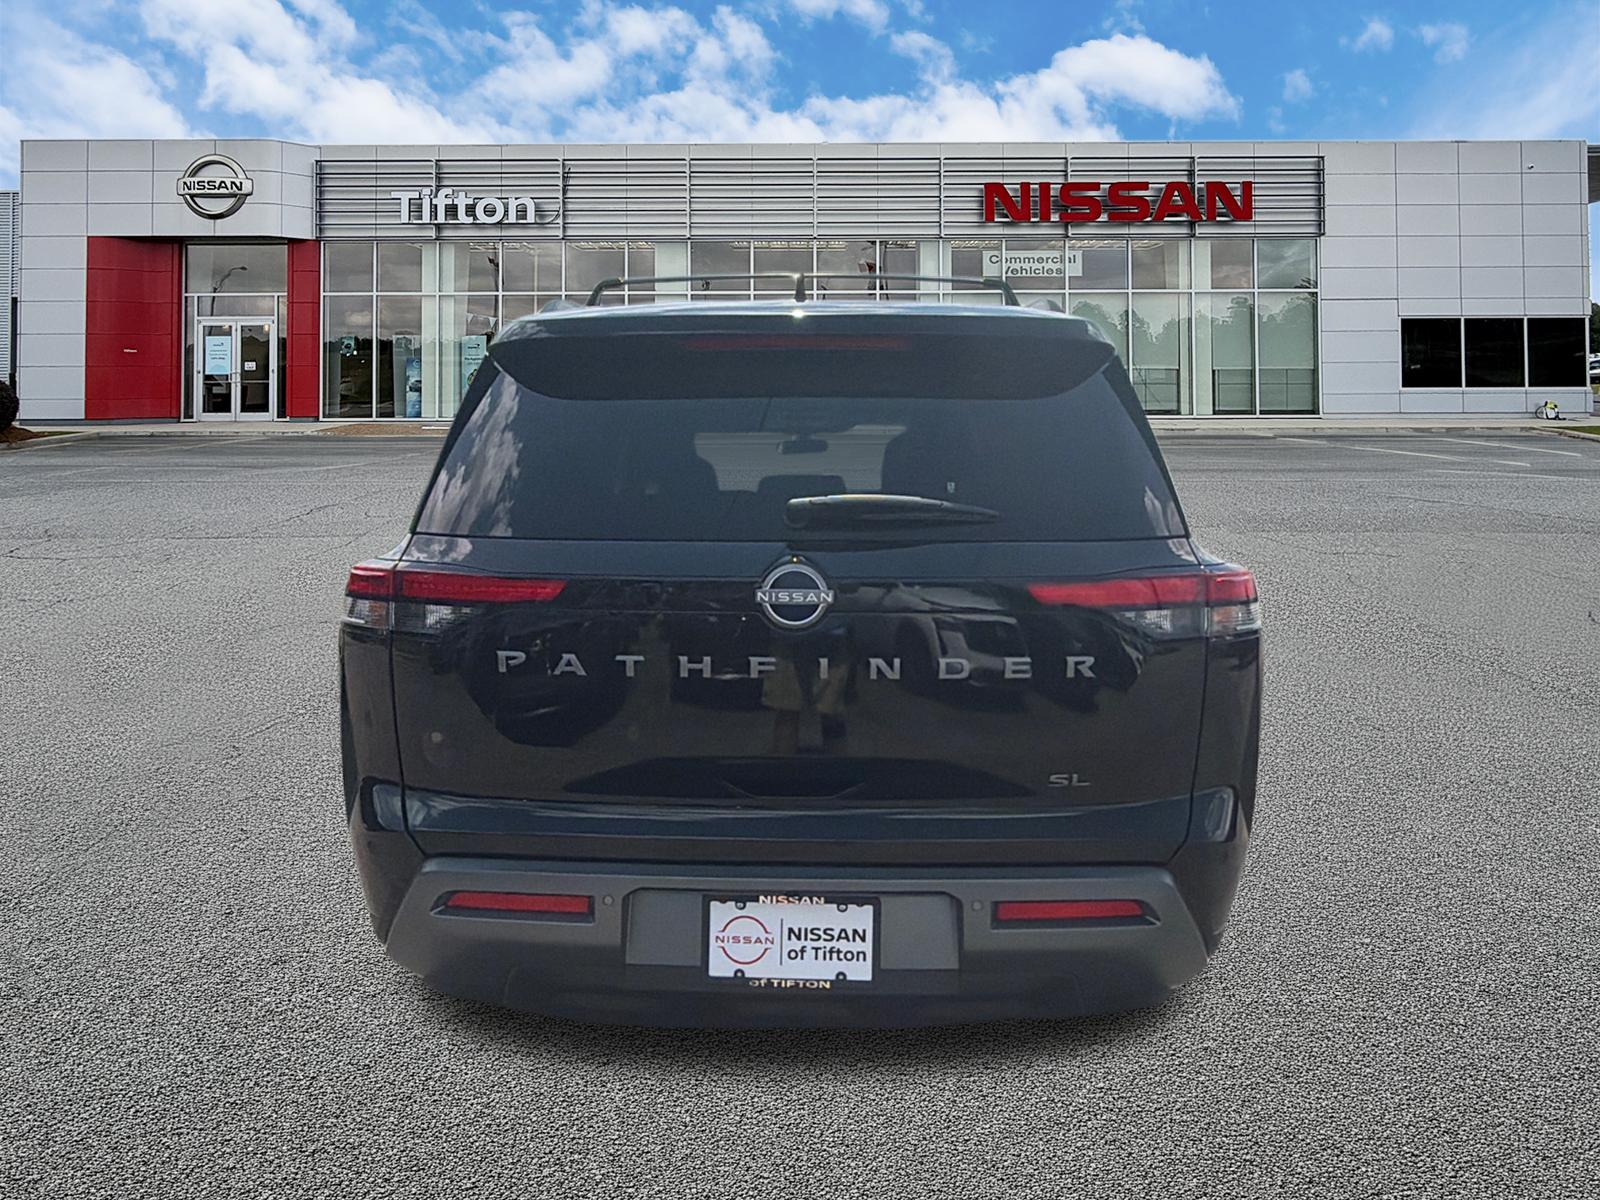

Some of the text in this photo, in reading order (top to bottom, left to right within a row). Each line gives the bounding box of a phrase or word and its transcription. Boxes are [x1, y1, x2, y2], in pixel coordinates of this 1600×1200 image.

[182, 180, 243, 191] NISSAN
[391, 188, 536, 224] Tifton
[984, 181, 1253, 222] NISSAN
[757, 592, 832, 602] NISSAN
[496, 650, 1097, 680] PATHFINDER
[1049, 774, 1091, 787] SL
[758, 895, 825, 905] NISSAN
[715, 935, 775, 945] NISSAN
[787, 927, 867, 943] NISSAN
[787, 946, 867, 962] of Tifton
[749, 978, 831, 989] of TIFTON
